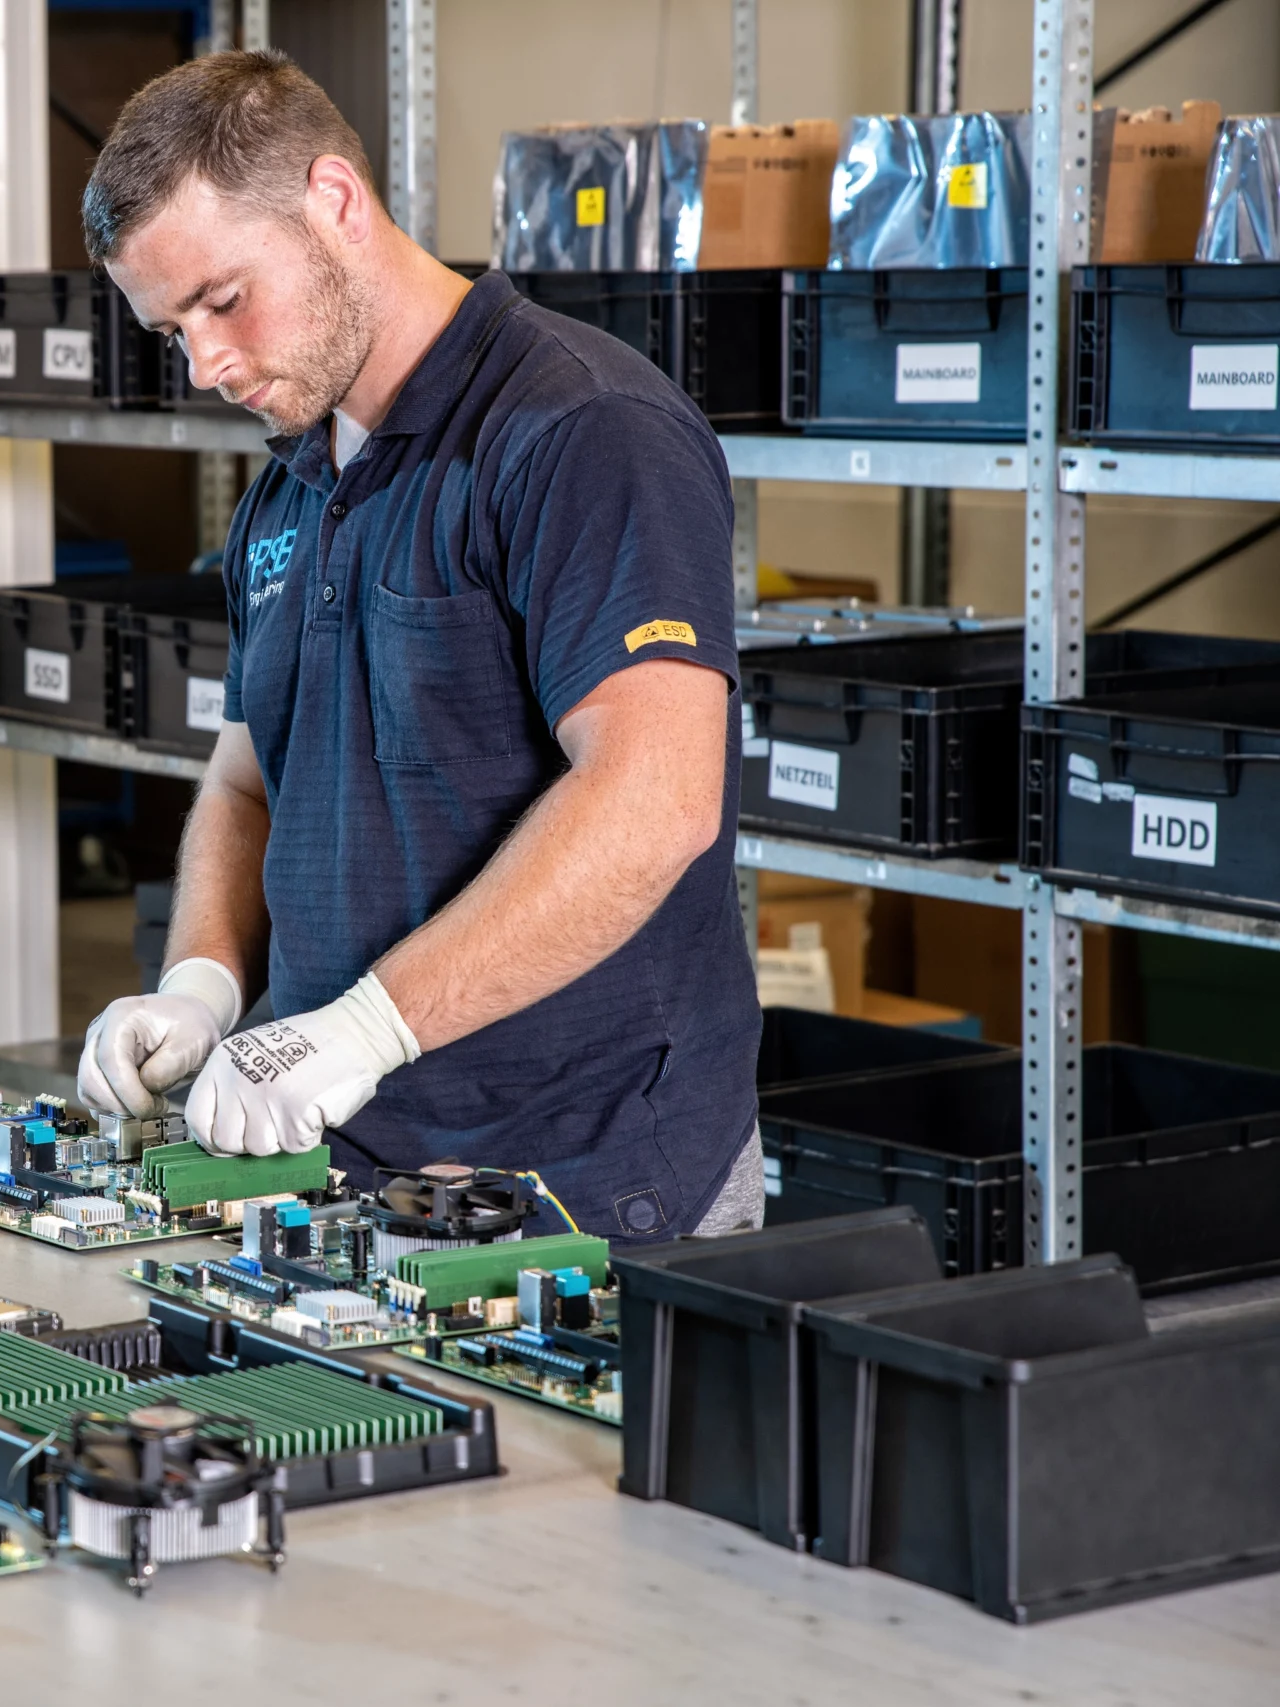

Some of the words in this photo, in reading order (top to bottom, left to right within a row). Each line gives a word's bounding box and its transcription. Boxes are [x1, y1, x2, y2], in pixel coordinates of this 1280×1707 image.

[52, 344, 86, 369] CPU
[902, 367, 977, 381] MAINBOARD
[1196, 371, 1276, 386] MAINBOARD
[663, 624, 687, 638] ESD
[33, 663, 63, 690] SSD
[192, 692, 223, 716] LÜFT
[775, 763, 835, 790] NETZTEIL
[1142, 813, 1210, 851] HDD
[231, 1037, 253, 1056] 130
[252, 1056, 280, 1083] LEO
